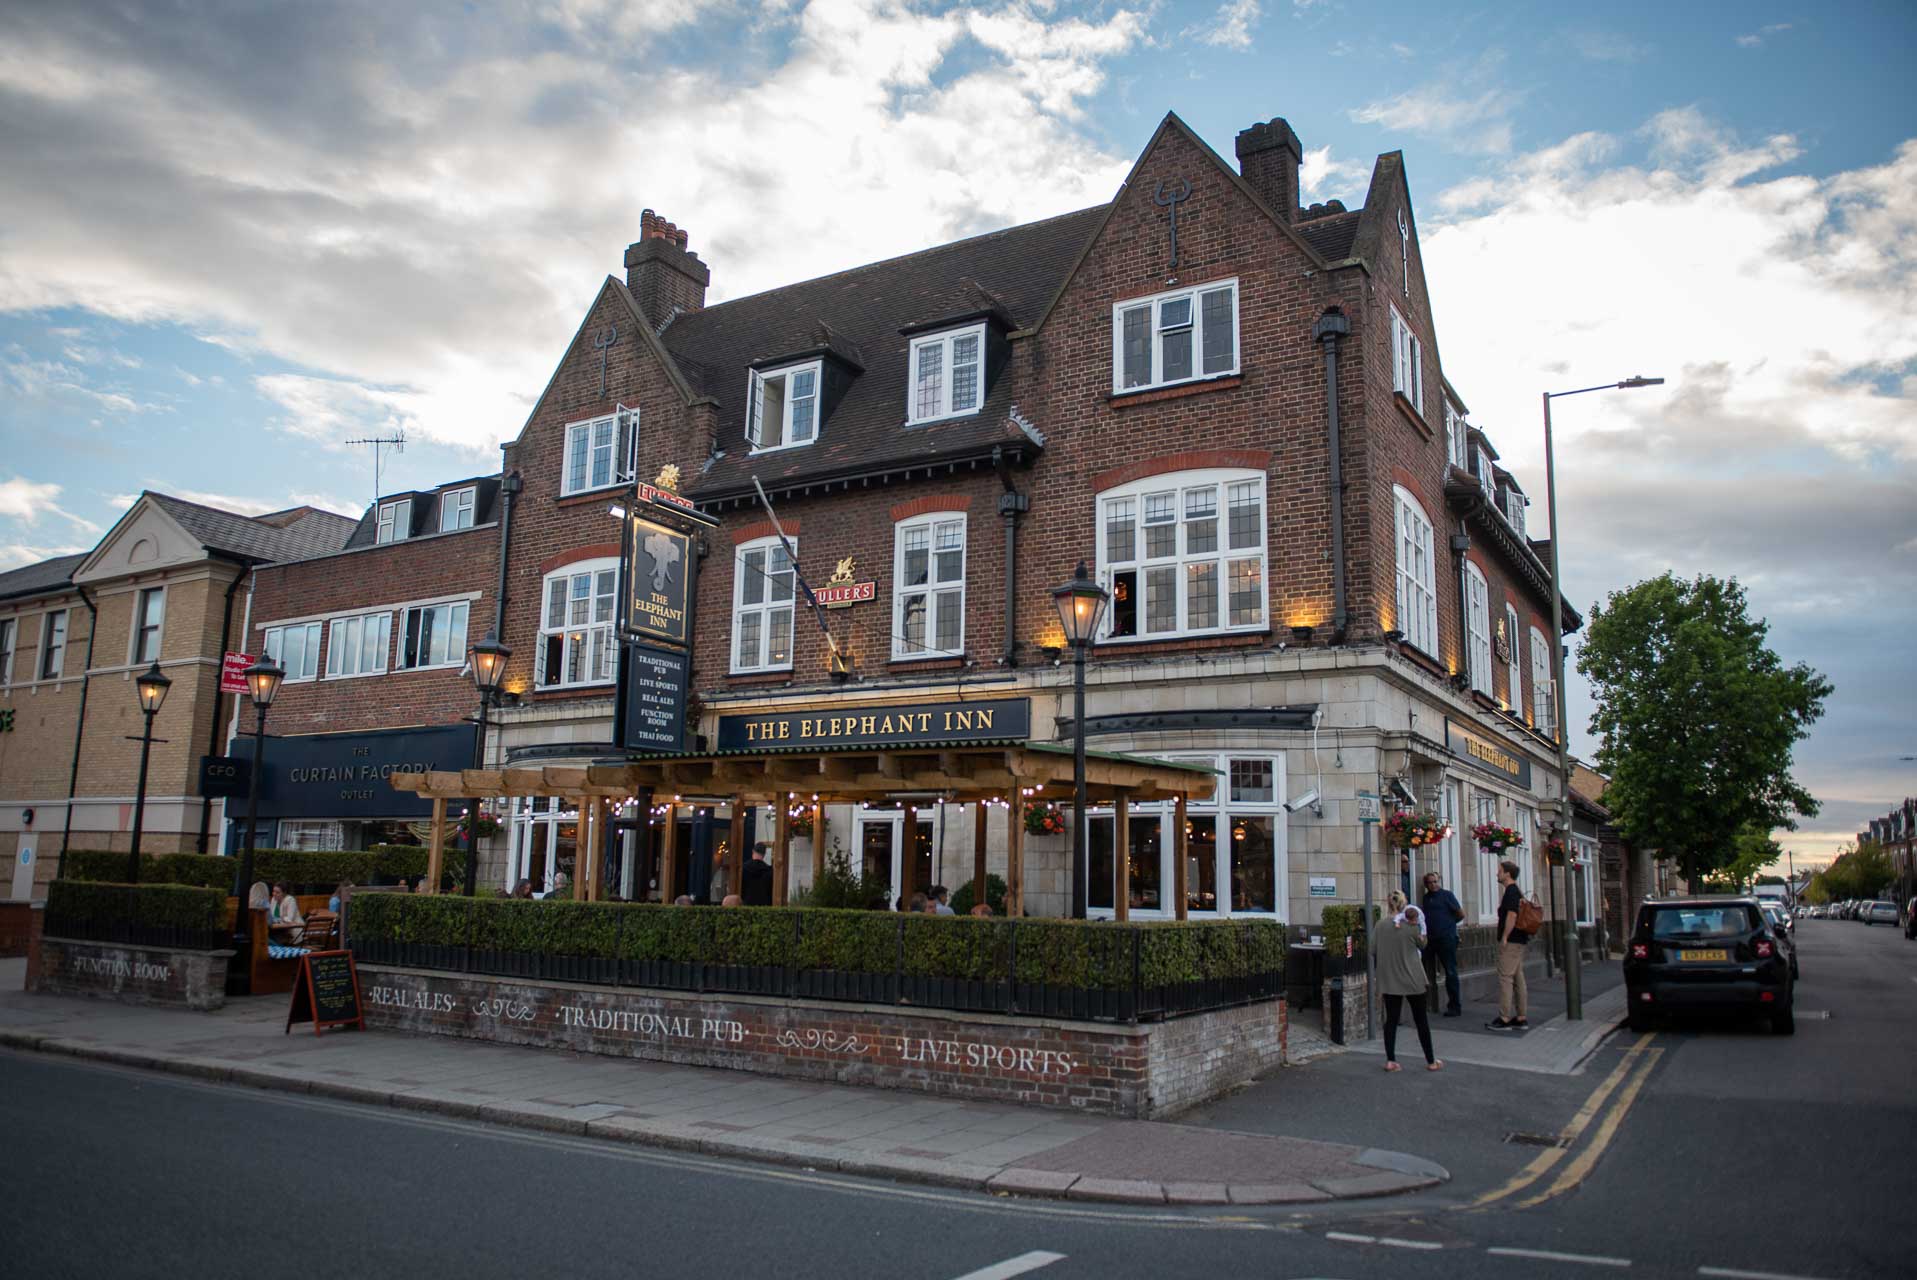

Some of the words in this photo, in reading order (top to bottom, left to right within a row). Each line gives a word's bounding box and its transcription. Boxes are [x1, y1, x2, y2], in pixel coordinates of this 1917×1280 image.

[651, 592, 668, 605] THE
[814, 585, 870, 602] ULLER'S
[635, 599, 682, 621] ELEPHANT
[650, 615, 667, 628] INN
[639, 656, 681, 670] TRADITIONAL
[653, 666, 667, 674] PUB
[640, 678, 654, 688] LIVE
[655, 681, 678, 691] SPORTS
[642, 694, 658, 703] REAL
[660, 697, 674, 705] ALES
[641, 709, 674, 720] FUNCTION
[648, 717, 667, 726] ROOM
[745, 721, 790, 740] THE
[800, 712, 933, 738] ELEPHANT
[944, 709, 995, 731] INN
[639, 731, 655, 740] THAI
[656, 733, 674, 742] FOOD
[352, 747, 369, 757] THE
[208, 764, 235, 777] CFO
[291, 766, 354, 782] CURTAIN
[341, 790, 374, 800] OUTLET
[77, 957, 131, 977] FUNCTION
[134, 962, 168, 981] ROOM
[372, 986, 410, 1008] REAL
[412, 991, 453, 1013] ALES
[561, 1005, 695, 1038] TRADITIONAL
[701, 1018, 744, 1042] PUB
[901, 1037, 961, 1065] LIVE
[966, 1042, 1071, 1075] SPORTS
